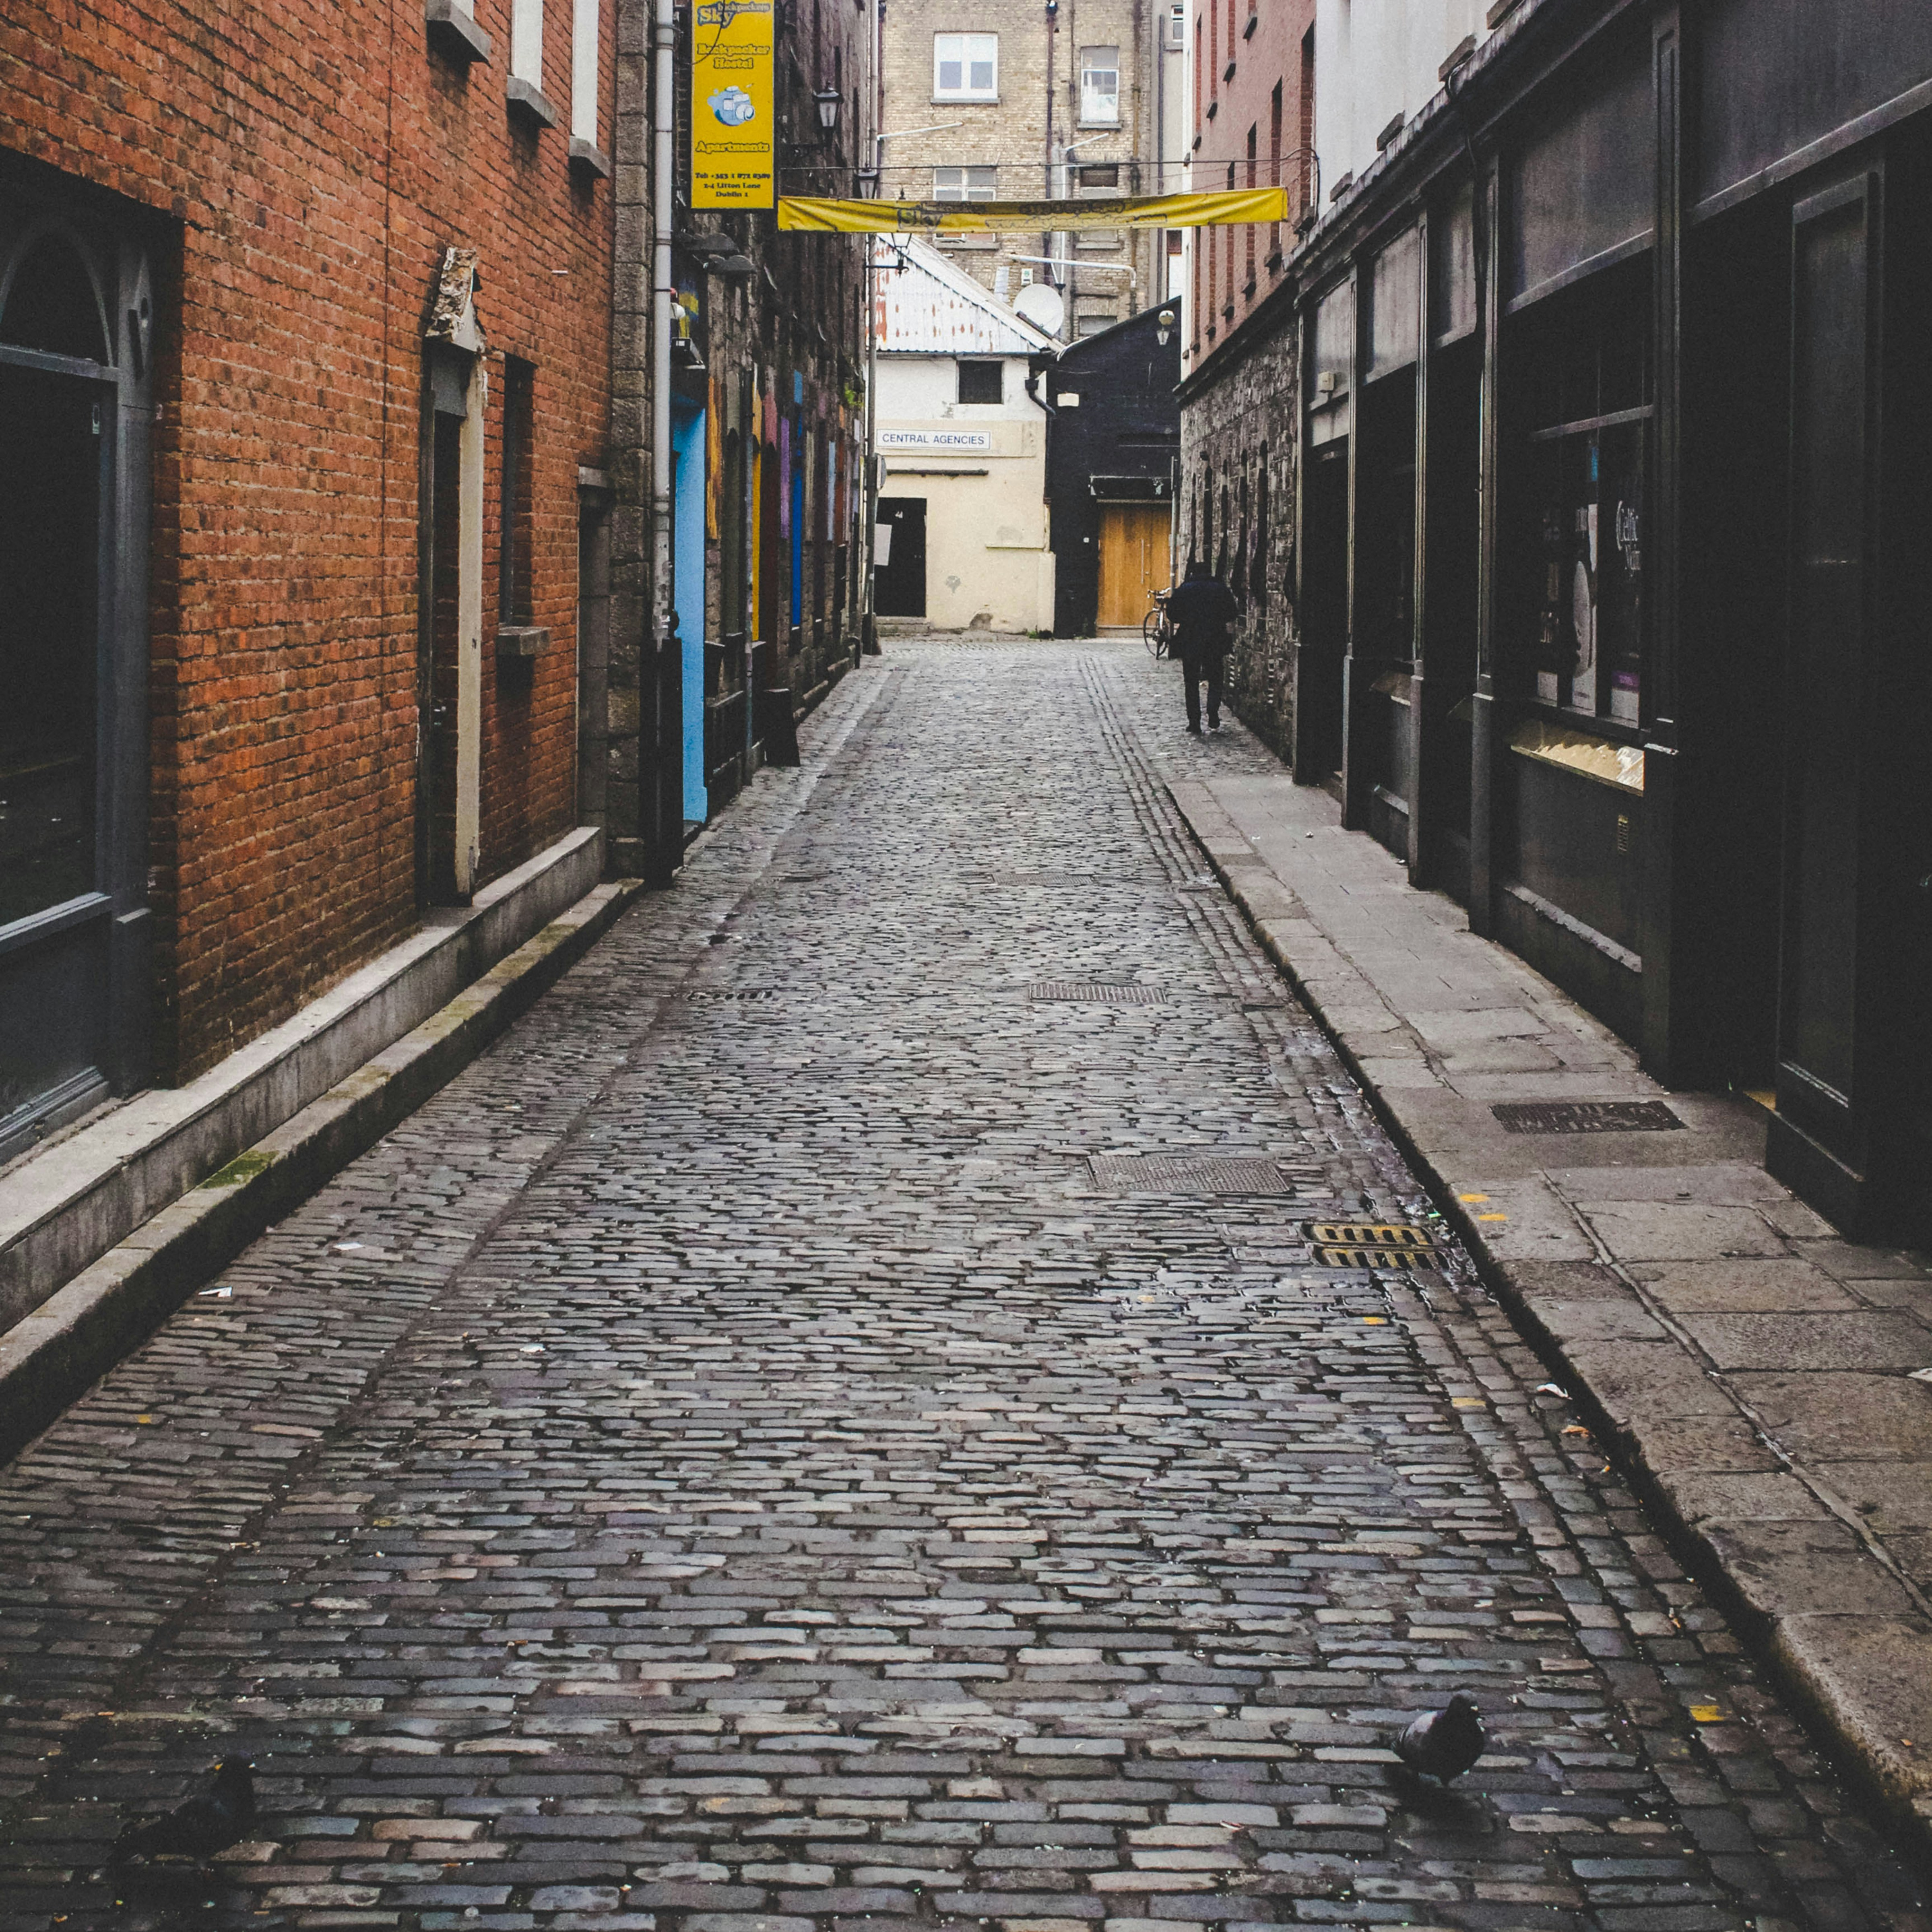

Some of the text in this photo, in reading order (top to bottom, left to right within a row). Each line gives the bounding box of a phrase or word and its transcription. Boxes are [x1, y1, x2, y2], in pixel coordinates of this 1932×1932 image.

[698, 6, 734, 27] Sky
[698, 43, 770, 56] Backpacker
[714, 57, 753, 68] Hostel
[696, 141, 770, 154] Apartments
[882, 433, 984, 444] CENTRAL AGENCIES
